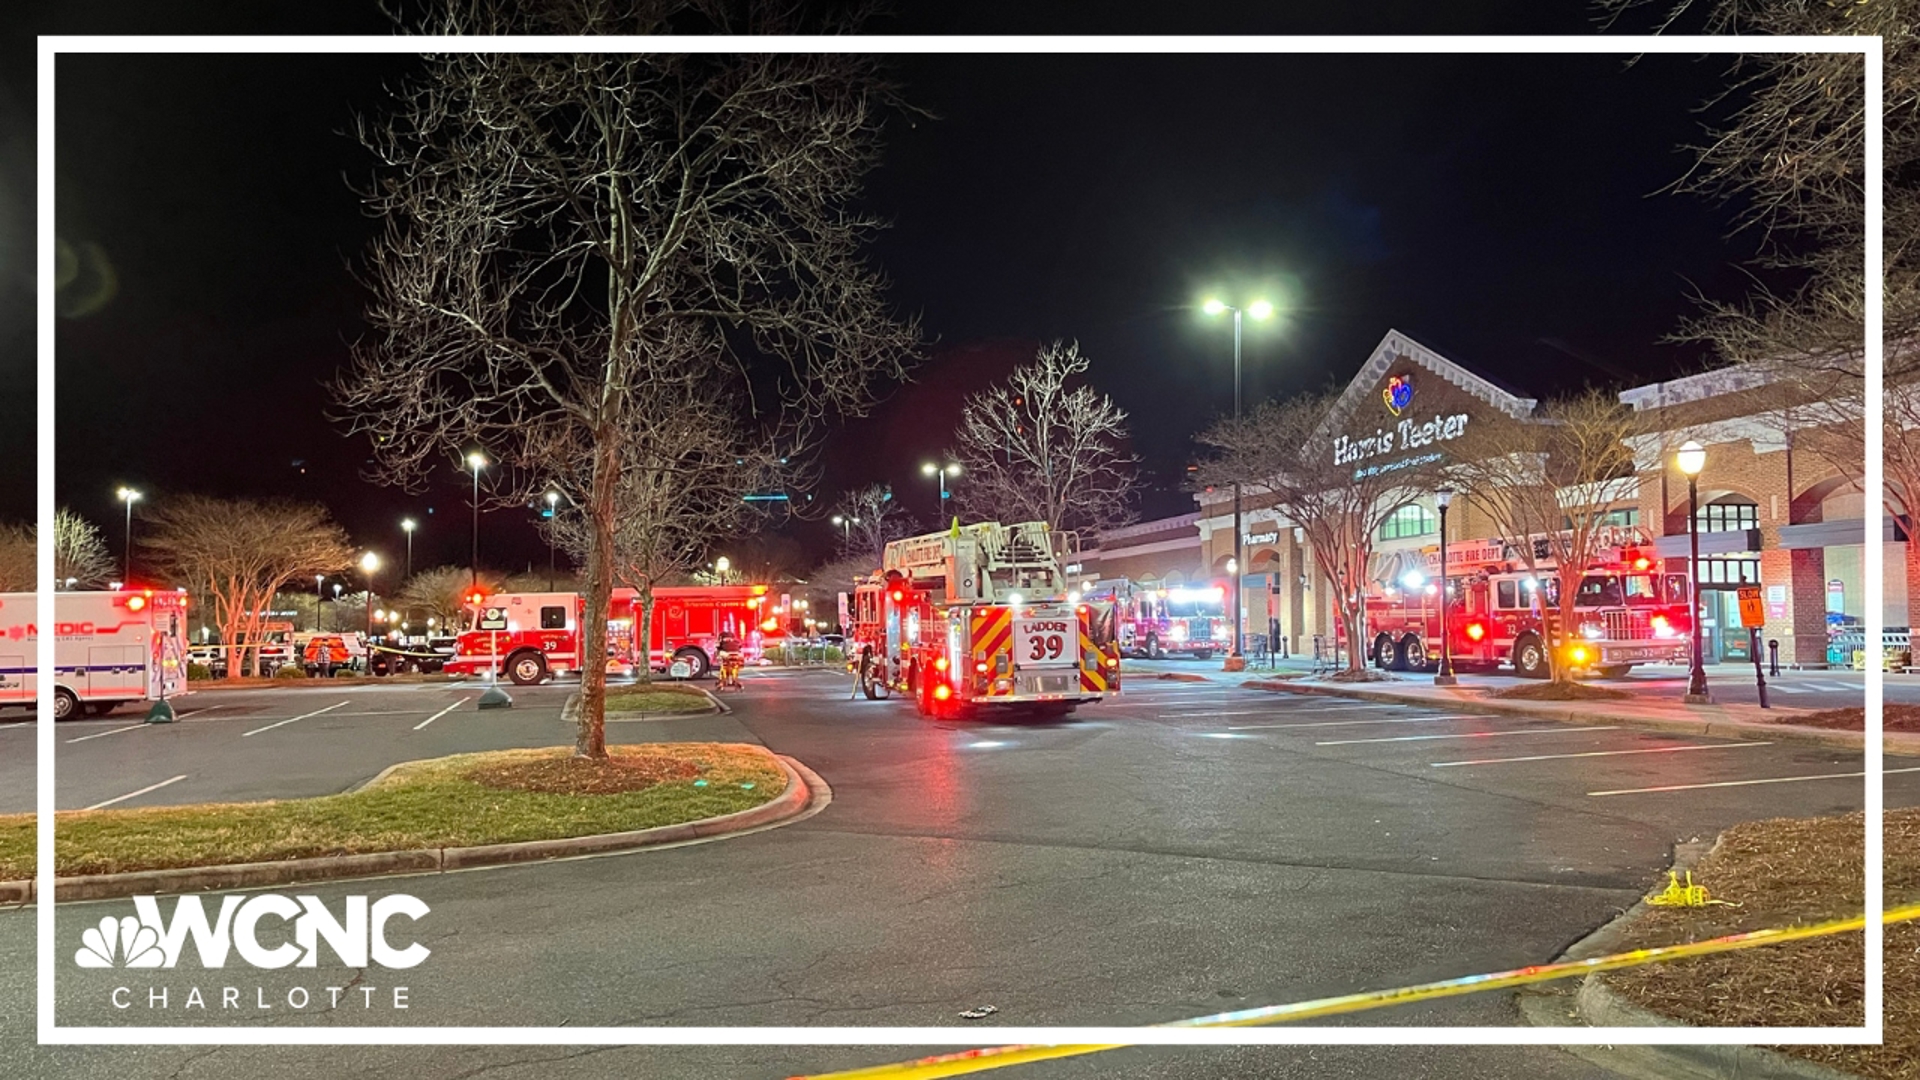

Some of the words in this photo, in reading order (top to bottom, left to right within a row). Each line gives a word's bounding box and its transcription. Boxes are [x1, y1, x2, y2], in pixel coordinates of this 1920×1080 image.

[1334, 429, 1394, 466] Harris
[1398, 413, 1468, 450] Teeter
[1242, 532, 1279, 546] Pharmacy
[1429, 550, 1463, 565] CHALOTTE
[1465, 549, 1479, 562] FIRE
[1739, 589, 1759, 599] SLOW
[1023, 621, 1067, 634] LADDER
[543, 641, 557, 650] 39
[1029, 634, 1063, 661] 39
